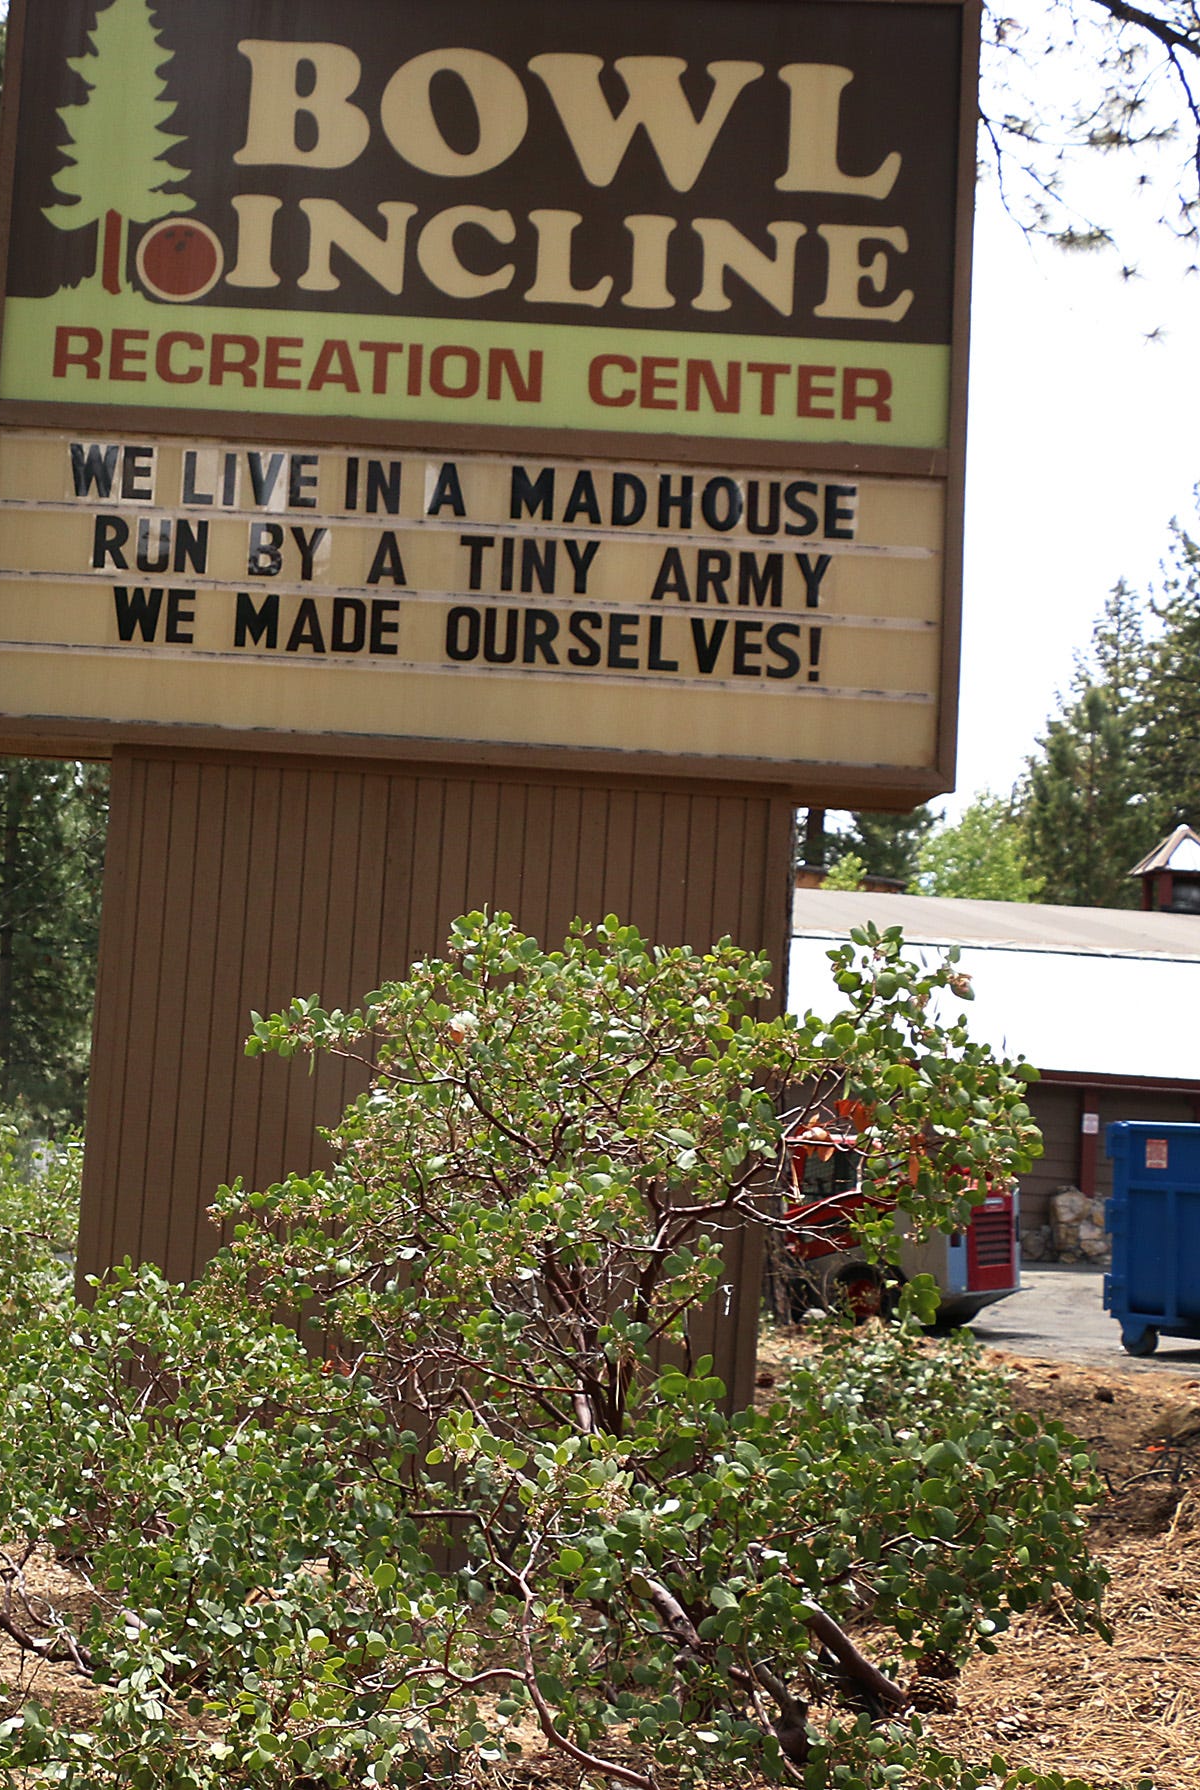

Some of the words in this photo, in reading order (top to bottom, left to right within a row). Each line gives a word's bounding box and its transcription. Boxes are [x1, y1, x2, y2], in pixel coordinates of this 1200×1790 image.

[233, 39, 902, 200] BOWL
[225, 195, 914, 322] INCLINE
[52, 326, 543, 402] RECREATION
[587, 353, 893, 421] CENTER
[70, 443, 154, 501] WE
[183, 451, 319, 509] LIVE
[345, 457, 401, 515] IN
[427, 462, 466, 517] A
[511, 467, 858, 540] MADHOUSE
[93, 515, 208, 575] RUN
[248, 523, 327, 581] BY
[366, 531, 406, 585] A
[460, 535, 600, 595] TINY
[651, 547, 832, 608] ARMY
[114, 586, 194, 645] WE
[233, 594, 399, 655] MADE
[446, 606, 822, 682] OURSELVES!
